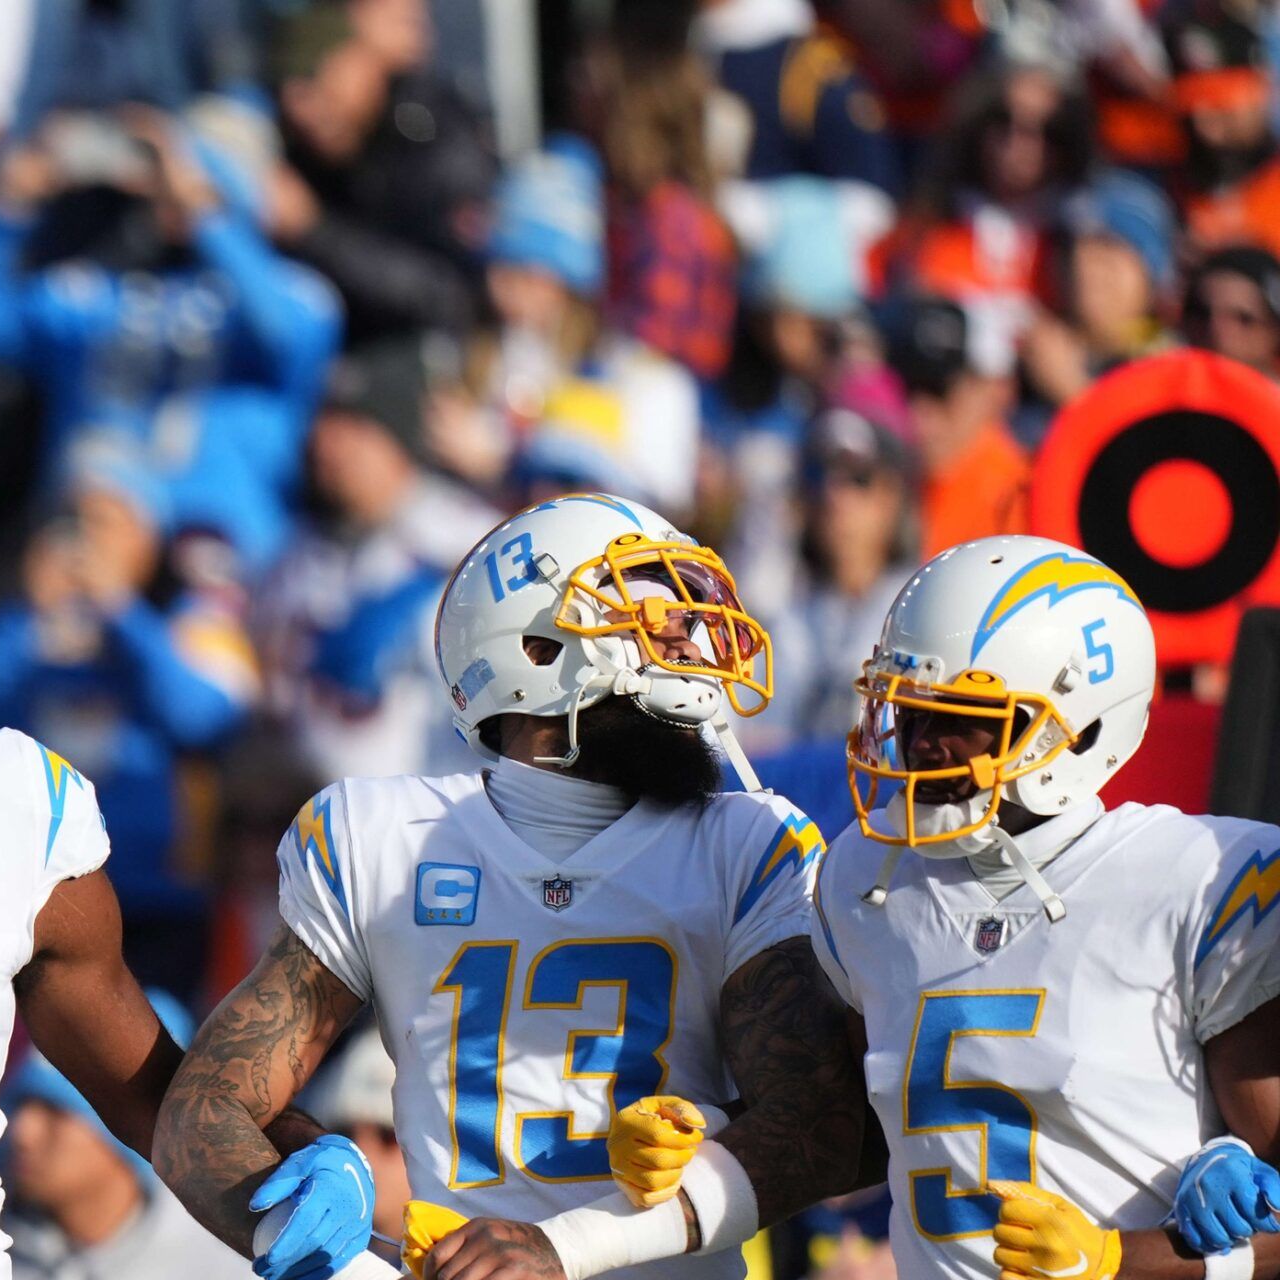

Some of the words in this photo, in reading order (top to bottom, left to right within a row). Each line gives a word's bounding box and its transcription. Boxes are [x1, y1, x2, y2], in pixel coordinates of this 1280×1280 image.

[483, 532, 541, 603] 13
[1081, 617, 1115, 685] 5
[420, 867, 475, 909] C
[545, 889, 570, 905] NFL
[430, 935, 680, 1191] 13
[901, 987, 1048, 1242] 5
